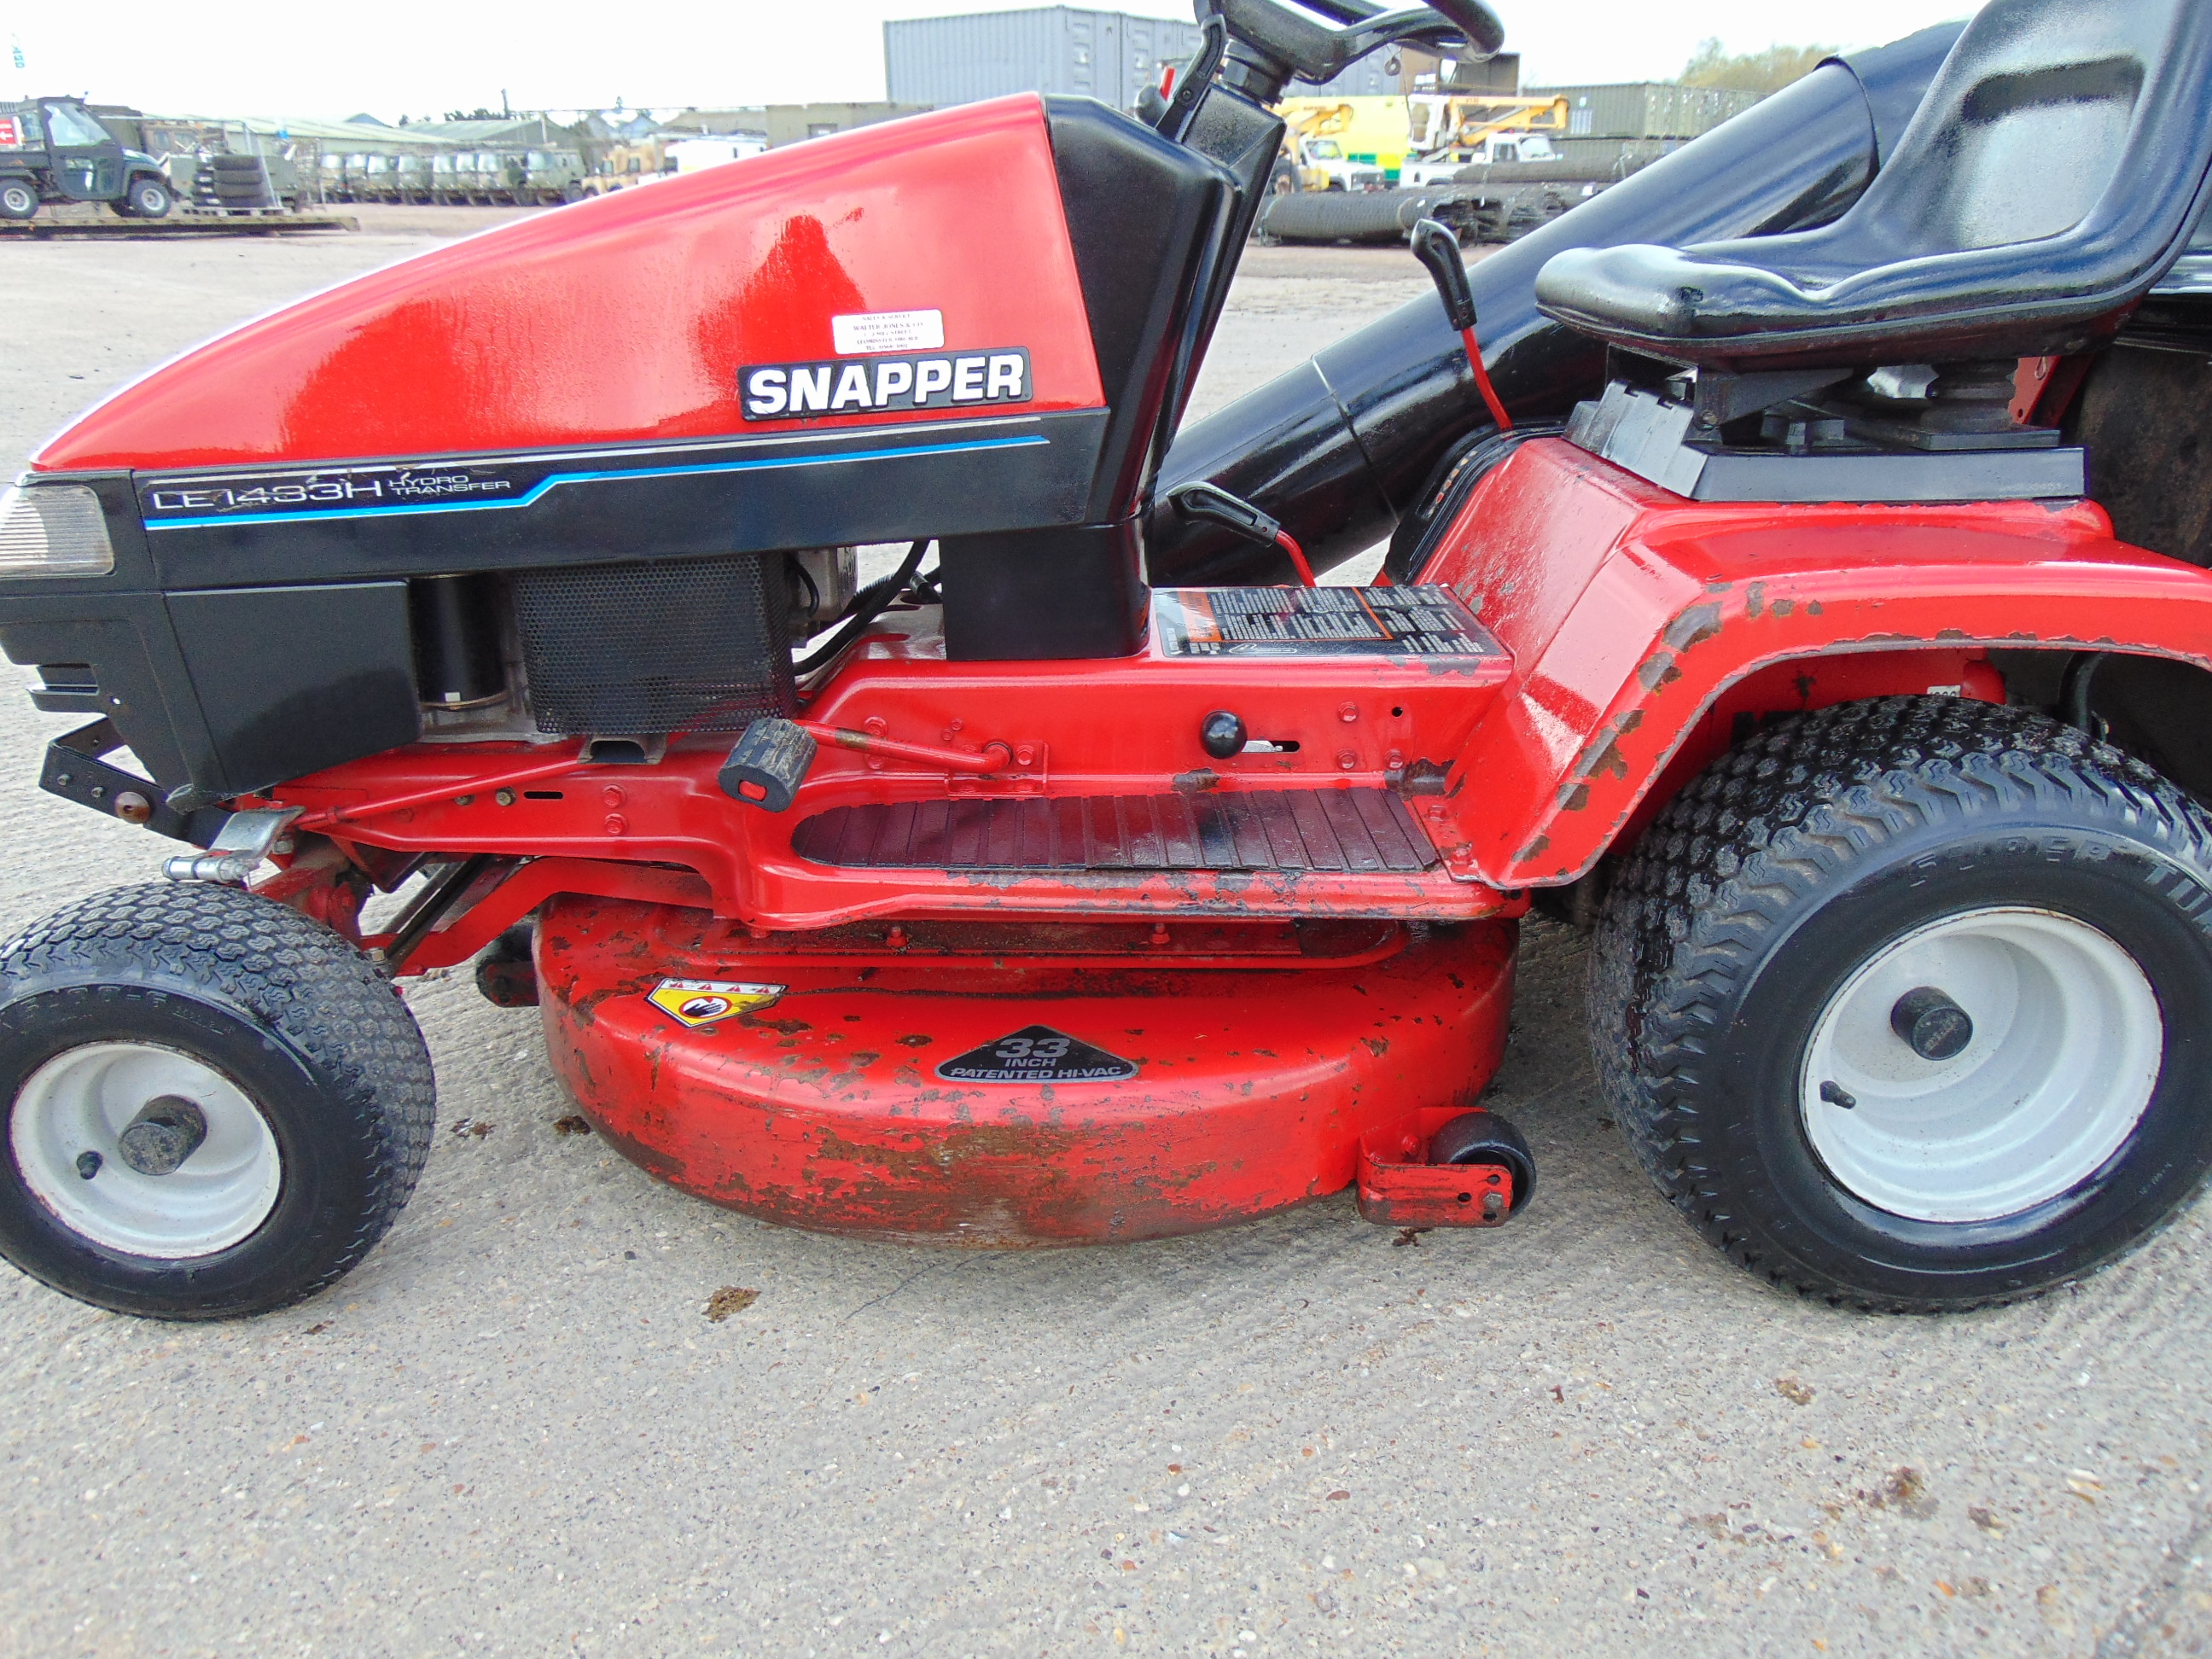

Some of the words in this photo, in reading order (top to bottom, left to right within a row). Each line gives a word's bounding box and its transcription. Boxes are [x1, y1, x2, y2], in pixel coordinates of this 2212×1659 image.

[748, 353, 1025, 415] SNAPPER
[389, 475, 469, 487] HYDRO
[391, 480, 511, 496] TRANSFER
[995, 1037, 1070, 1058] 33
[1004, 1057, 1057, 1068] INCH
[951, 1067, 1054, 1080] PATENTED
[1057, 1066, 1122, 1079] HI-VAC
